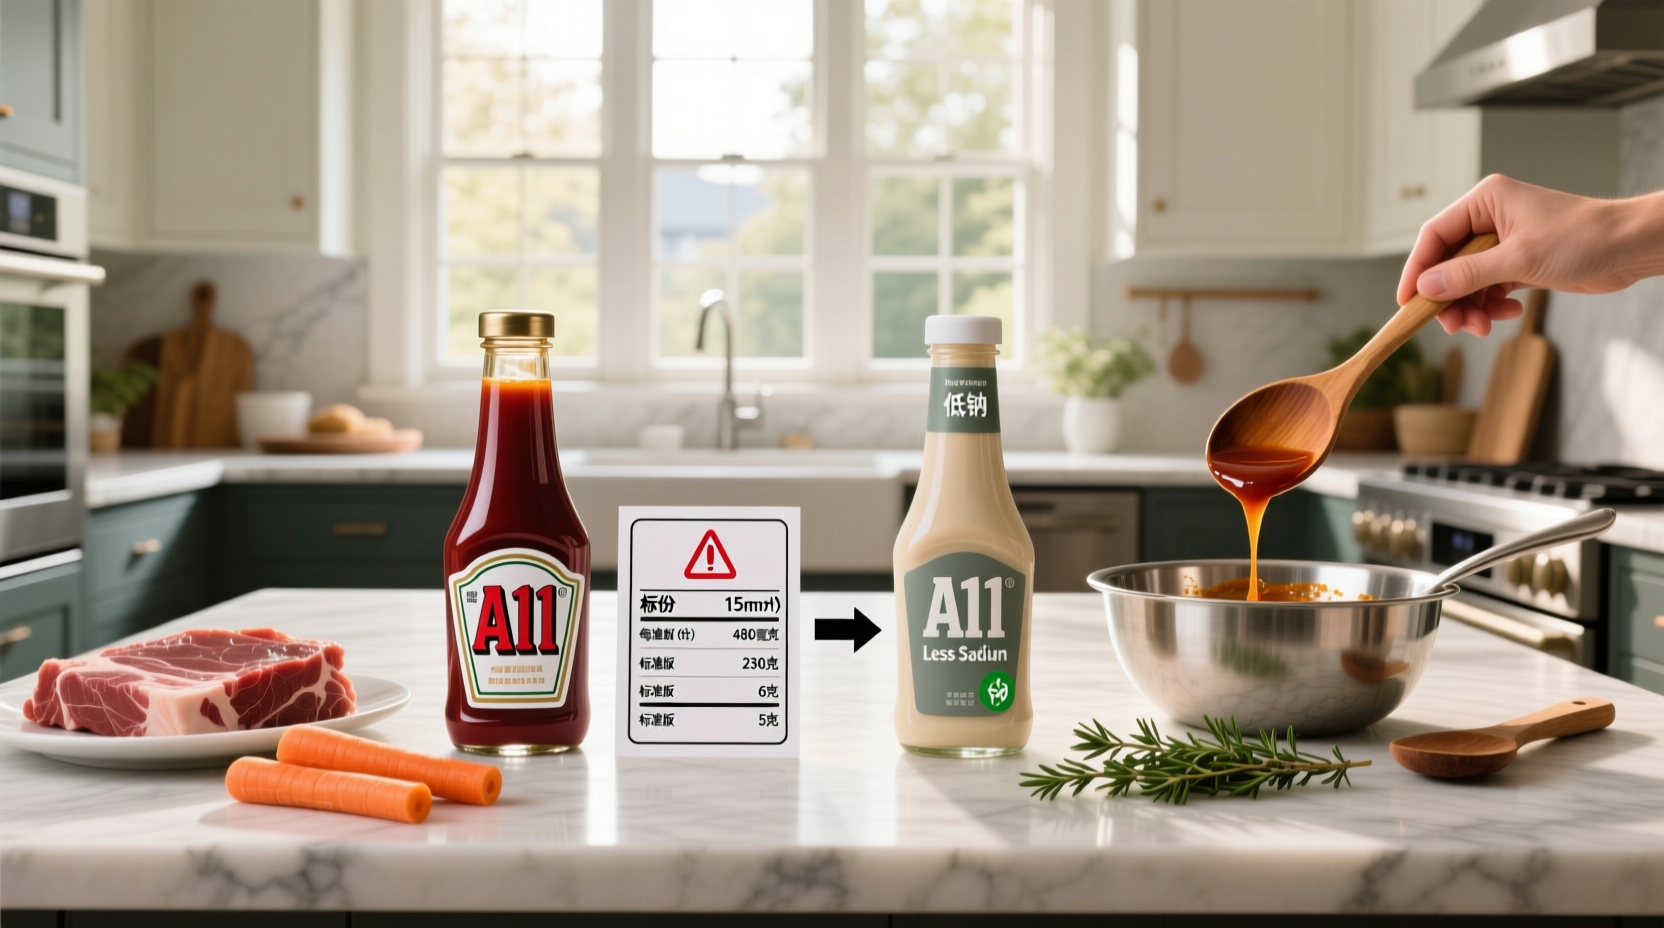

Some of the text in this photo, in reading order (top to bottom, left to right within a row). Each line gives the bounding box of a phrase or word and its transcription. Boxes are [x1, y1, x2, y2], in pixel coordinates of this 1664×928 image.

[943, 391, 987, 417] 低钠
[923, 645, 955, 661] Less
[742, 656, 779, 670] 230克
[758, 684, 779, 698] 6克
